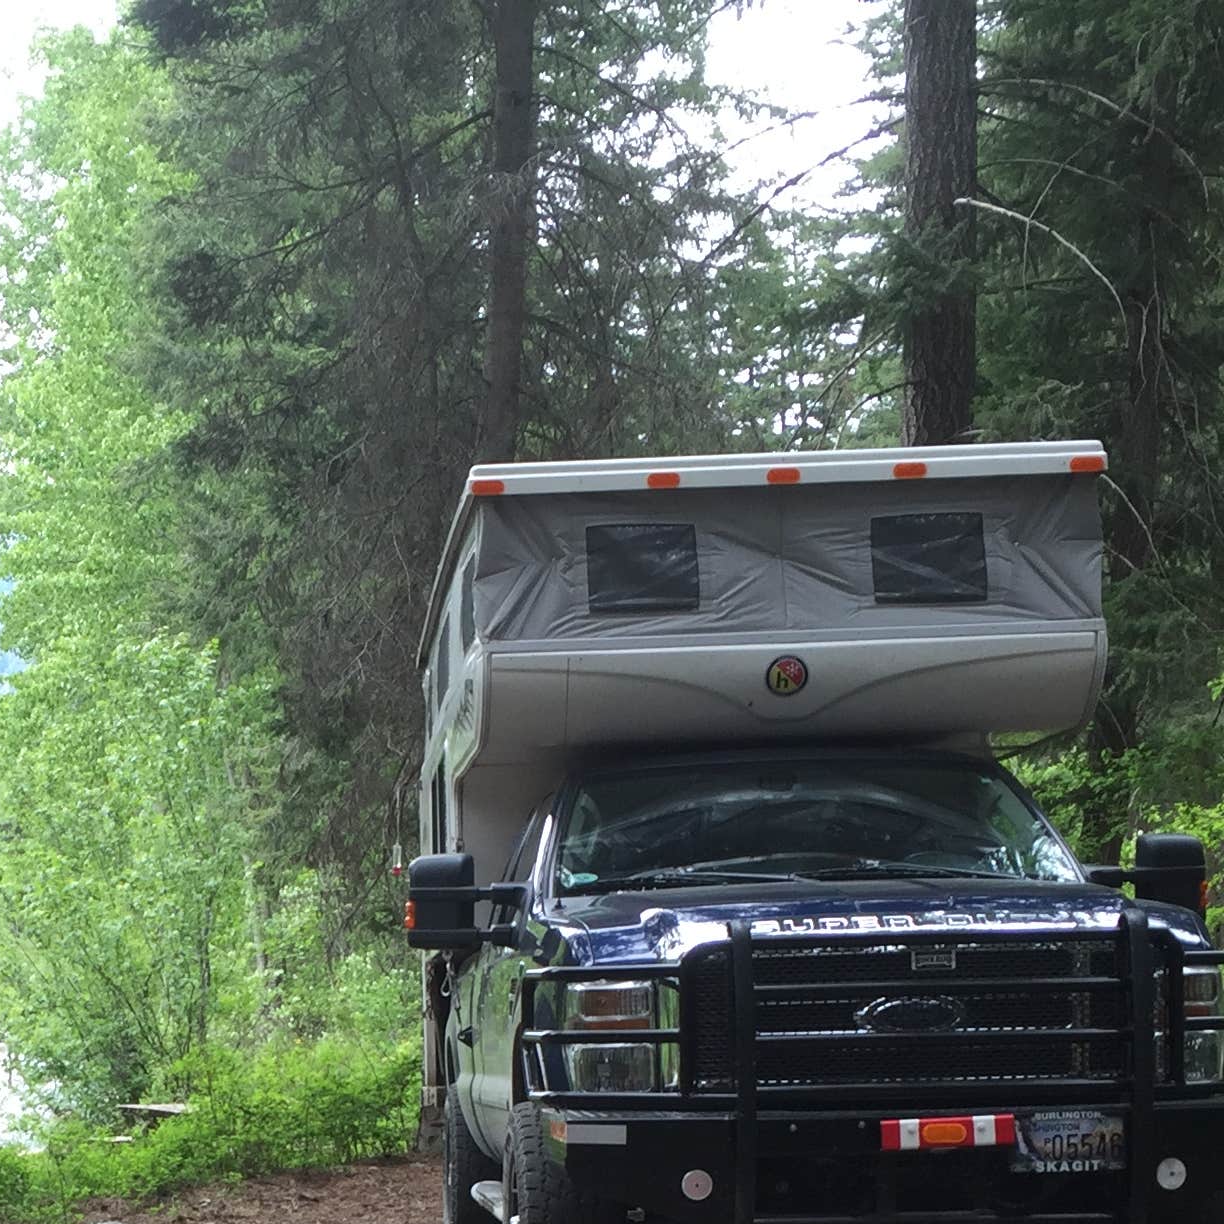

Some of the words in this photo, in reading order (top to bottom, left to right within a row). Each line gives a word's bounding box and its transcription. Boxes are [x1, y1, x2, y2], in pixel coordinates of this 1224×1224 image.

[751, 915, 916, 935] SUPER
[1033, 1110, 1102, 1121] BURLINGTON
[1035, 1159, 1102, 1173] SKAGIT
